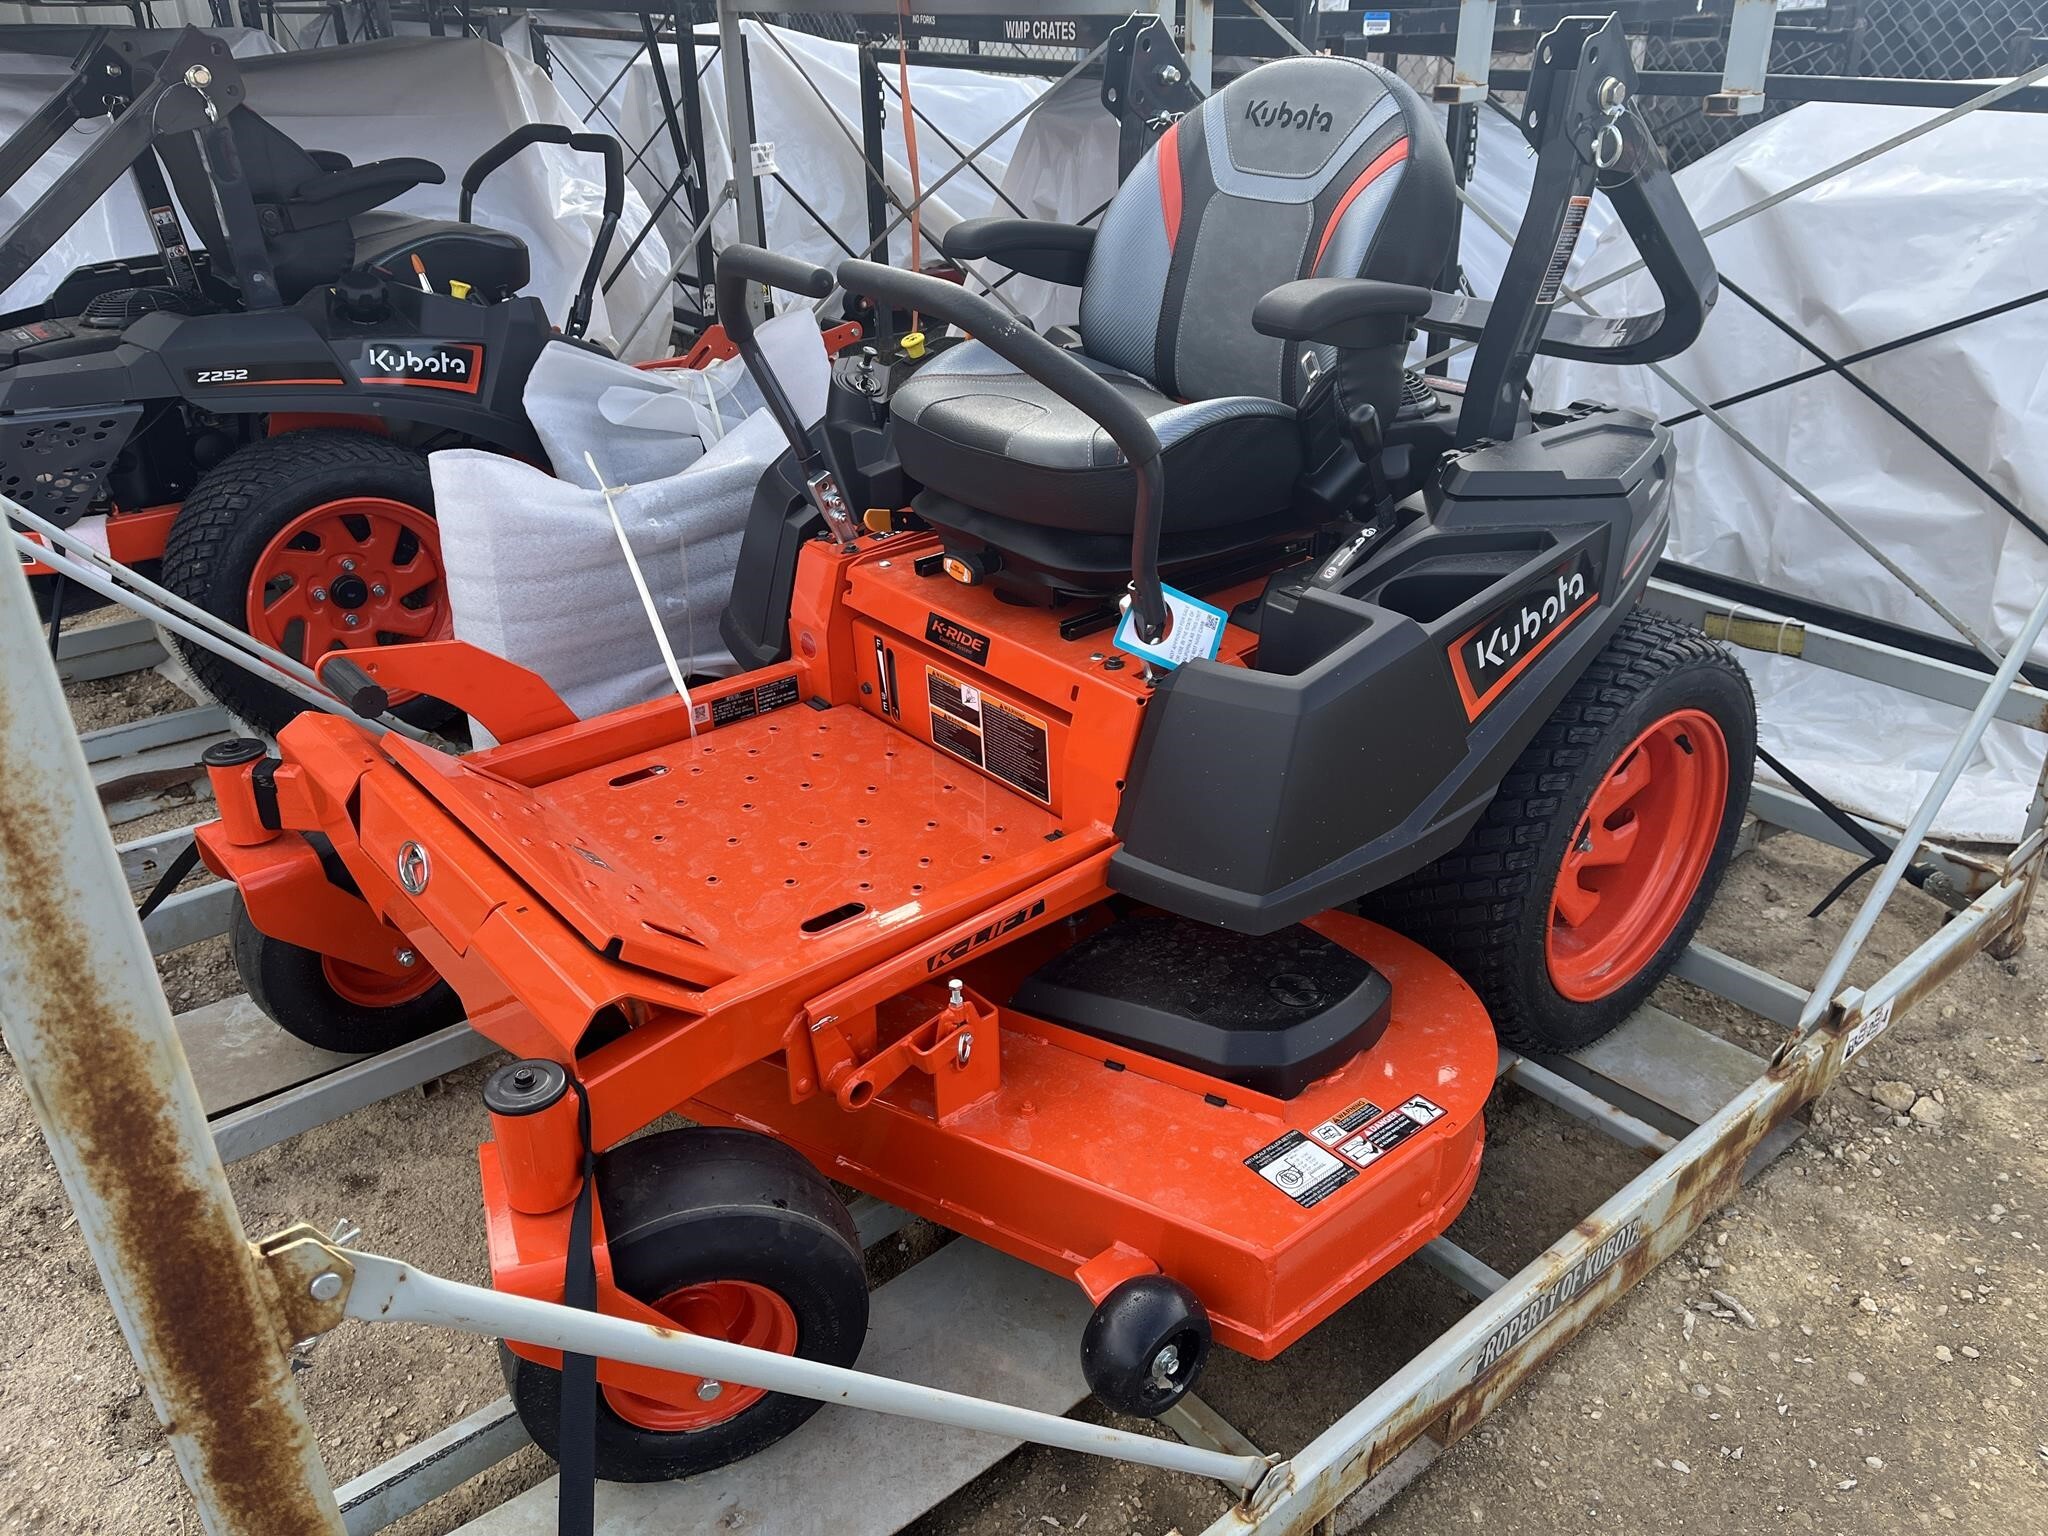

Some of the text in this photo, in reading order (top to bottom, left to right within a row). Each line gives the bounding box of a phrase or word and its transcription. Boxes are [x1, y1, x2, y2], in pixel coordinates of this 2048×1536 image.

[920, 14, 936, 25] FORKS
[1005, 20, 1076, 41] WMP CRATES
[1245, 100, 1333, 132] Kubota
[369, 349, 466, 374] Kubota
[197, 369, 248, 383] Z252
[1476, 573, 1585, 669] Kubota
[932, 620, 985, 652] K-RIDE
[931, 900, 1041, 970] K-LIFT
[1339, 1101, 1366, 1119] WARNING
[1371, 1111, 1400, 1132] DANGER
[1561, 1268, 1582, 1302] OF
[1583, 1216, 1642, 1284] KUBOTA
